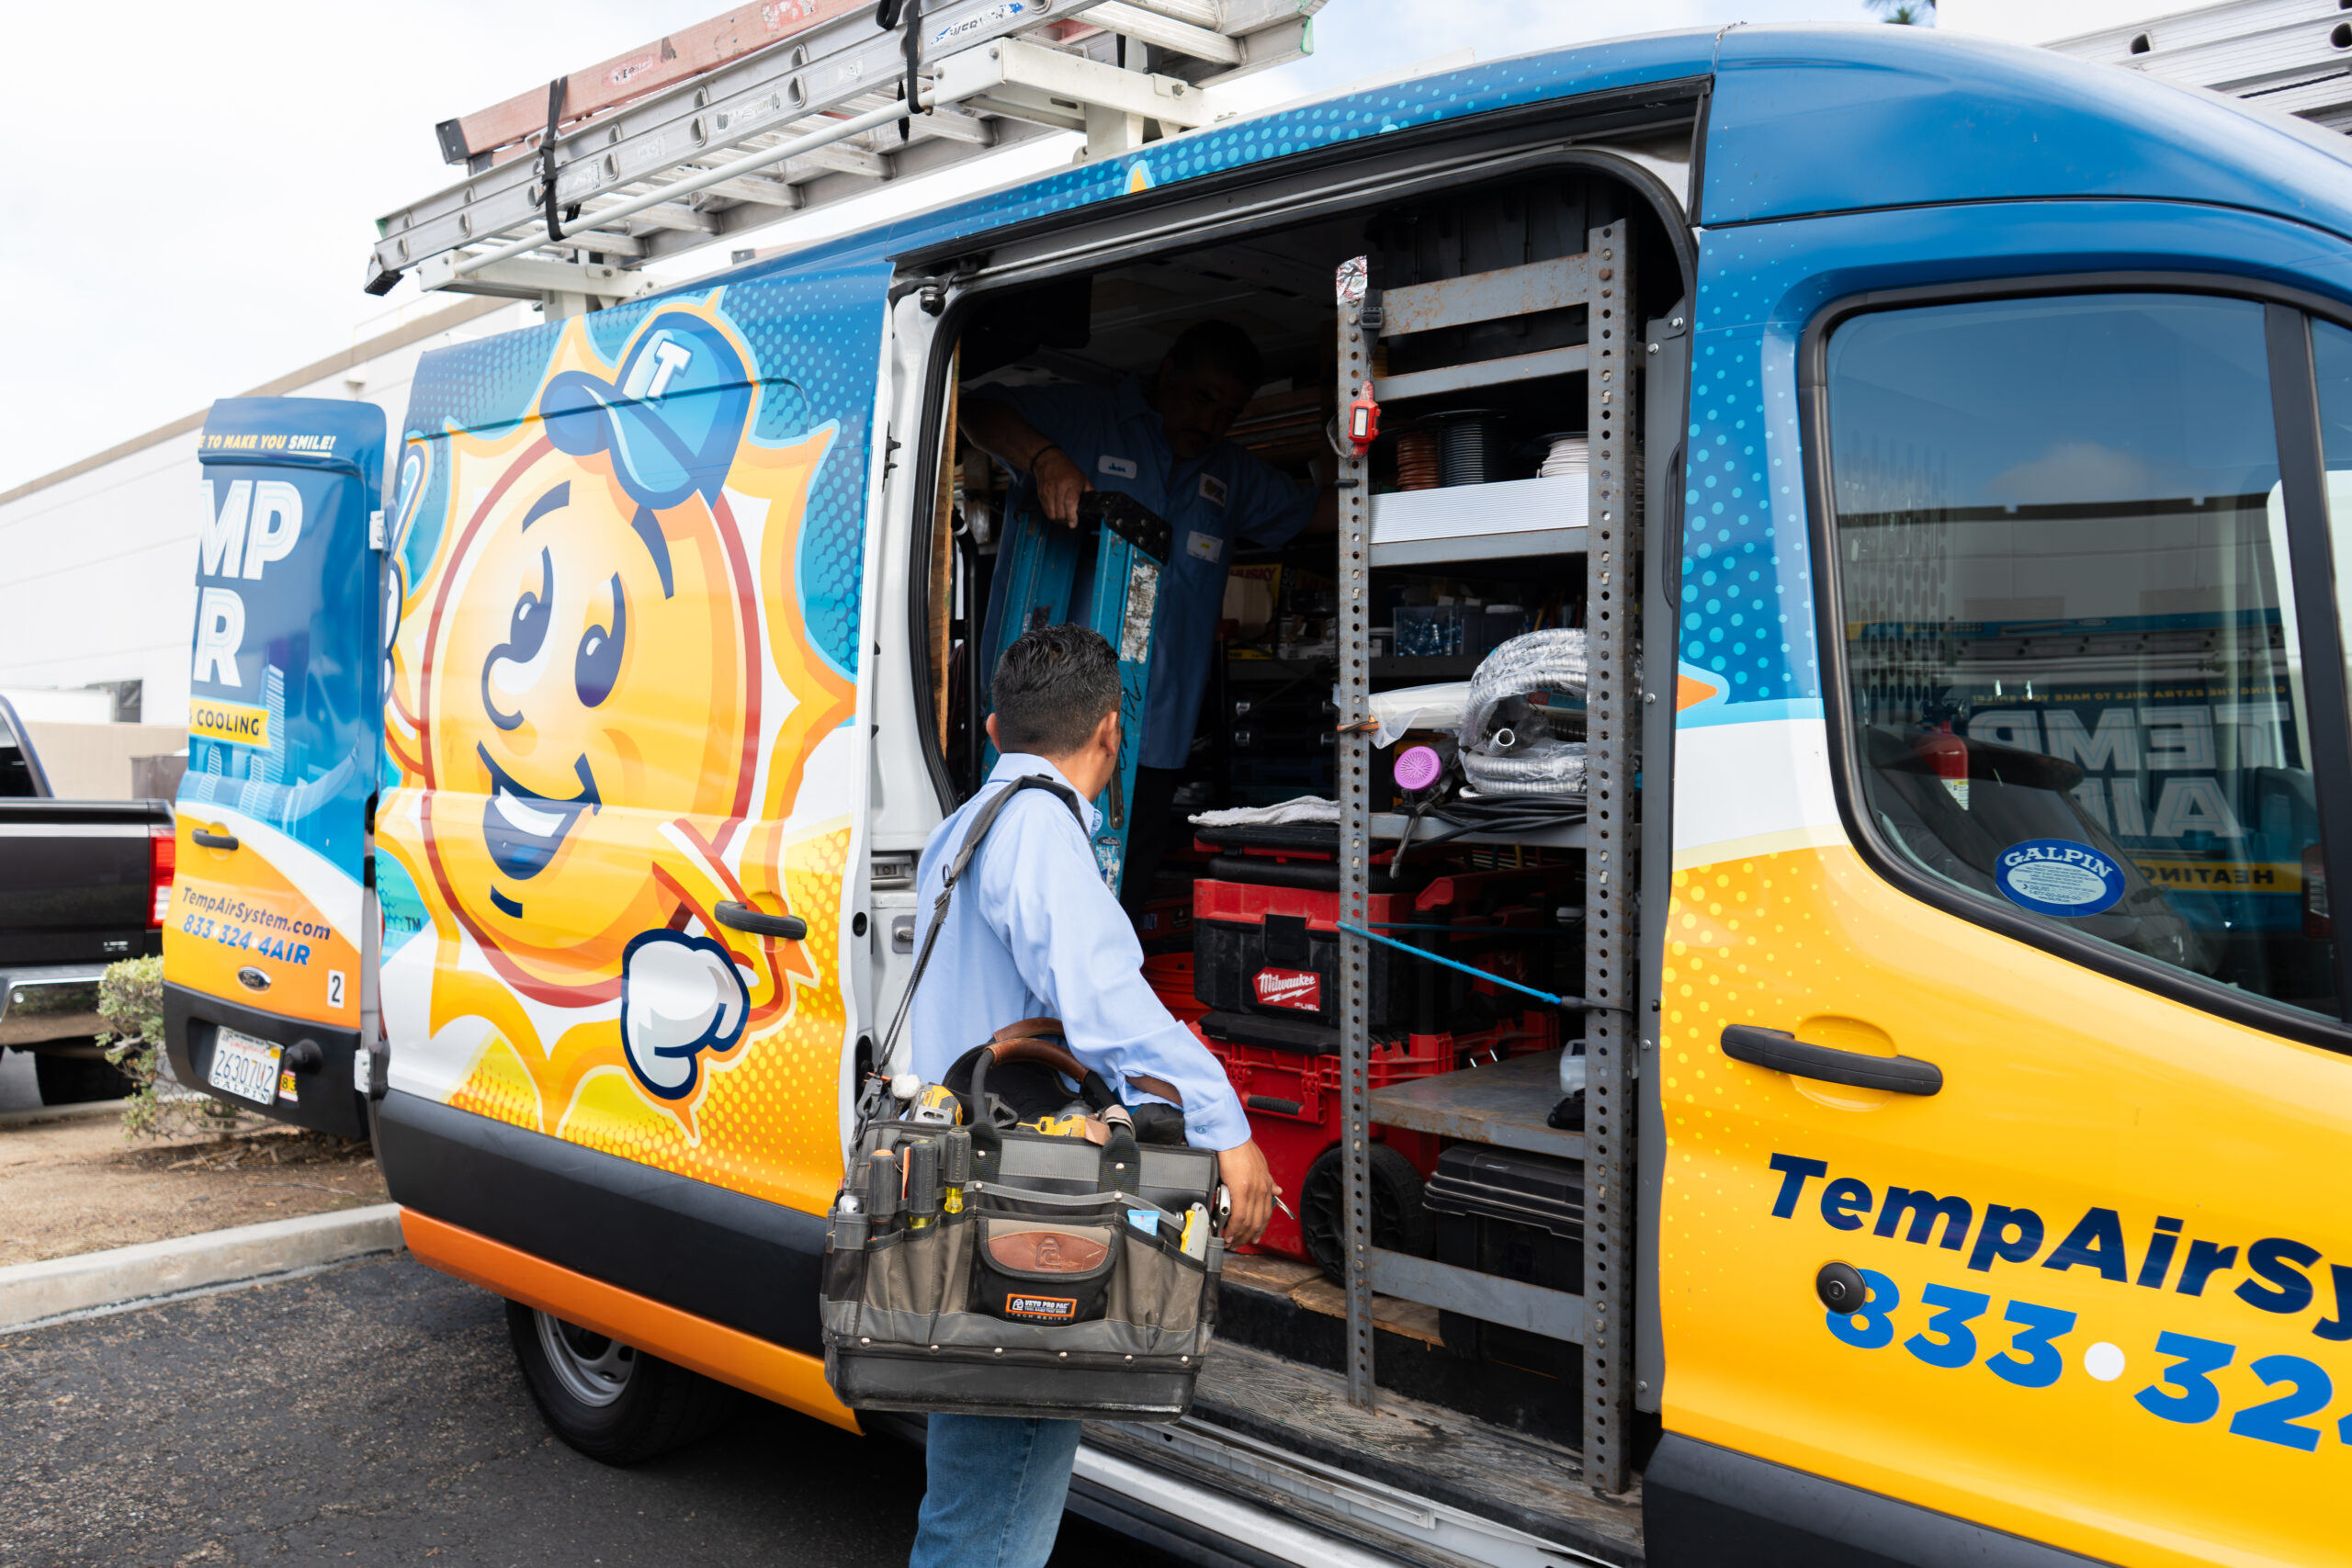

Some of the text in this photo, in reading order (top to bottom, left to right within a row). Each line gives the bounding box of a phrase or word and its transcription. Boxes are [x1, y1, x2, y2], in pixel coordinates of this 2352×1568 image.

[208, 435, 222, 448] TO
[223, 435, 258, 448] MAKE
[261, 435, 288, 449] YOU
[288, 435, 336, 450] SMILE!
[197, 709, 260, 736] COOLING
[2004, 847, 2113, 878] GALPIN
[183, 887, 331, 940] TempAirSystem.com
[405, 916, 422, 932] TM
[331, 976, 341, 1003] 2
[1257, 973, 1316, 994] Milwaukee
[1294, 1002, 1320, 1012] FUEL
[214, 1050, 275, 1092] 26307U2
[212, 1077, 268, 1100] GALPIN
